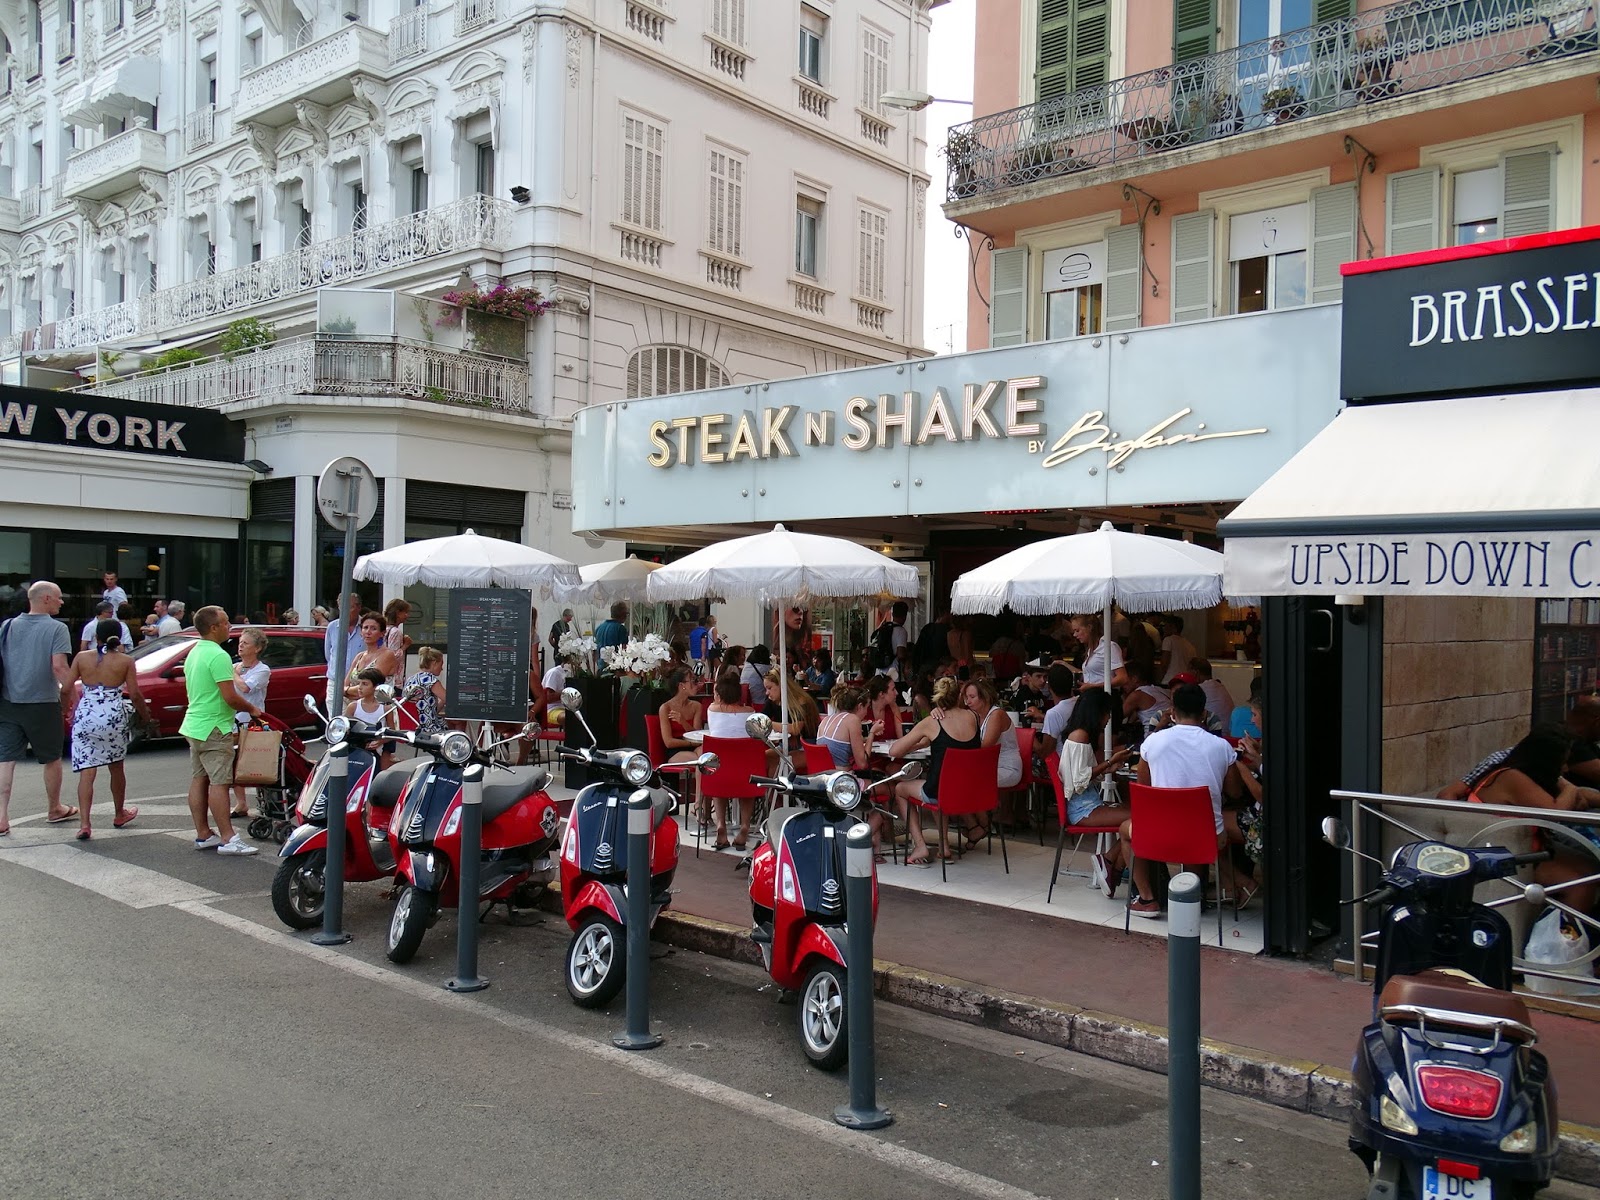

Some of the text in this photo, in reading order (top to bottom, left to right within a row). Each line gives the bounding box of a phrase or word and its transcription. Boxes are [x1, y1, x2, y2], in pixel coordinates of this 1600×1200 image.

[55, 407, 187, 452] YORK
[647, 405, 800, 469] STEAK
[841, 375, 1048, 452] SHAKE
[1028, 440, 1046, 454] BY
[1291, 539, 1600, 588] UPSIDE DOWN C
[1447, 1175, 1475, 1198] DC
